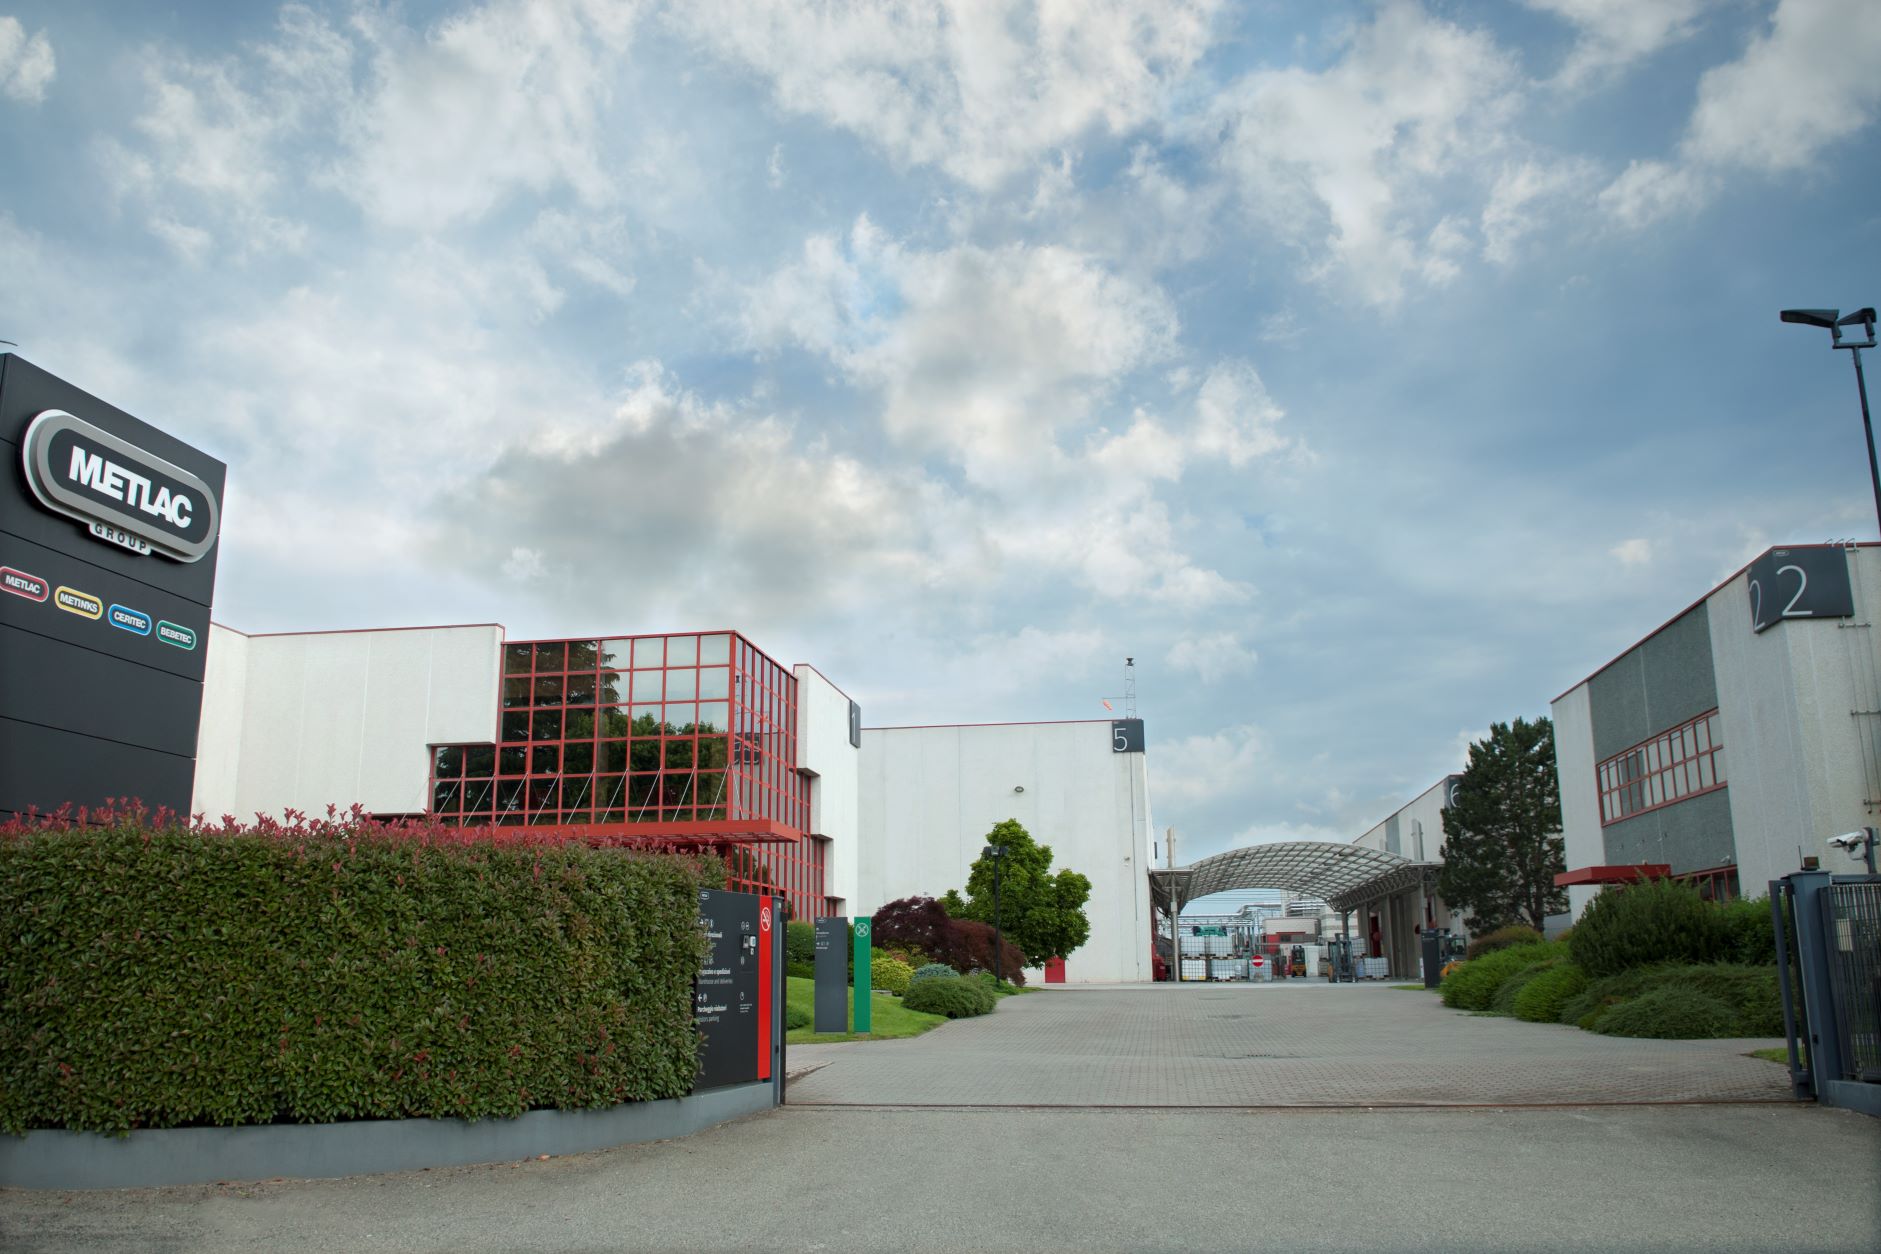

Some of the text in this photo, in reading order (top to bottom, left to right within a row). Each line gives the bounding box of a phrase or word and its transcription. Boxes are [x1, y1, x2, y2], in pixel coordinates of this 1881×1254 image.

[68, 445, 193, 529] METLAC
[94, 523, 147, 551] GROUP
[5, 574, 41, 594] METLAC
[1776, 565, 1813, 616] 2
[60, 592, 98, 613] METINKS
[1749, 580, 1765, 631] 2
[113, 611, 147, 629] CERITEC
[1113, 728, 1128, 751] 5
